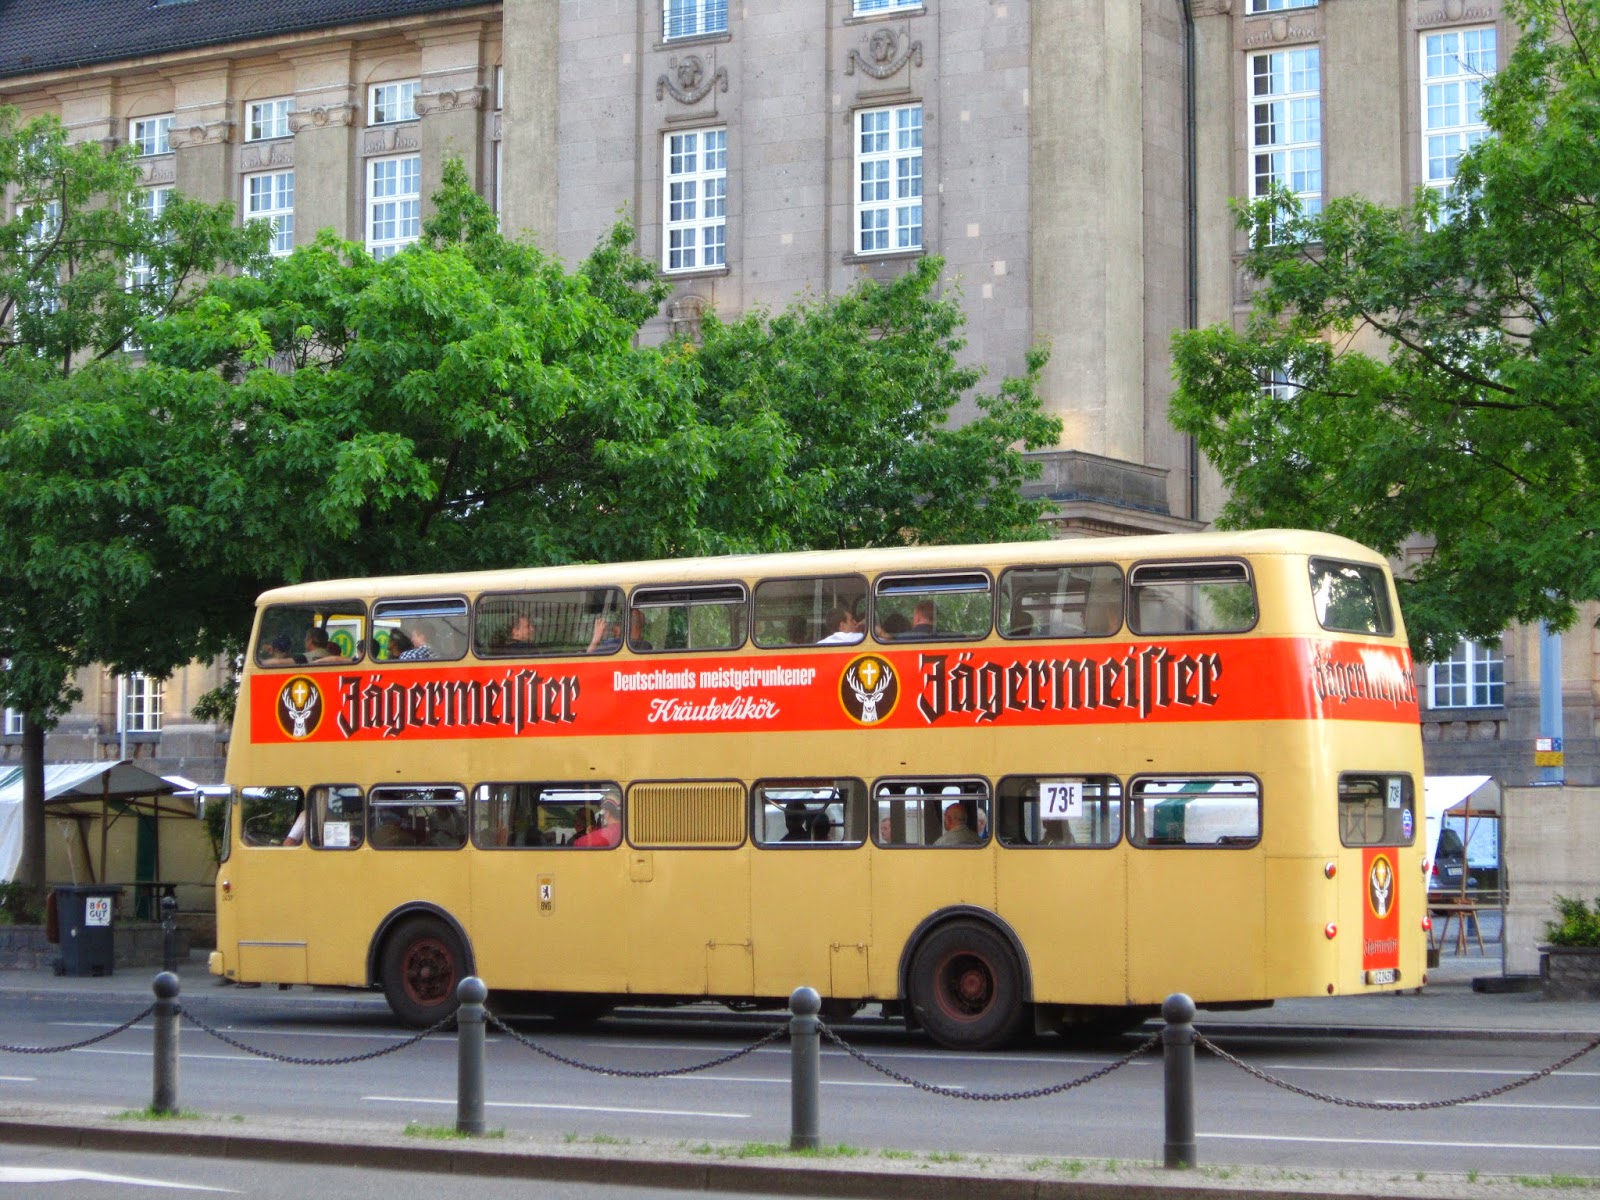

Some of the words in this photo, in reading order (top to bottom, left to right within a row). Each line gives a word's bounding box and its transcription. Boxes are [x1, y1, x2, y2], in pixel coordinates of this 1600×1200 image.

[613, 668, 697, 692] Deutschlands
[699, 665, 816, 691] meistgetrunkener
[647, 696, 781, 723] Kräuterlikör
[1047, 786, 1075, 813] 73E
[89, 909, 108, 918] GUT
